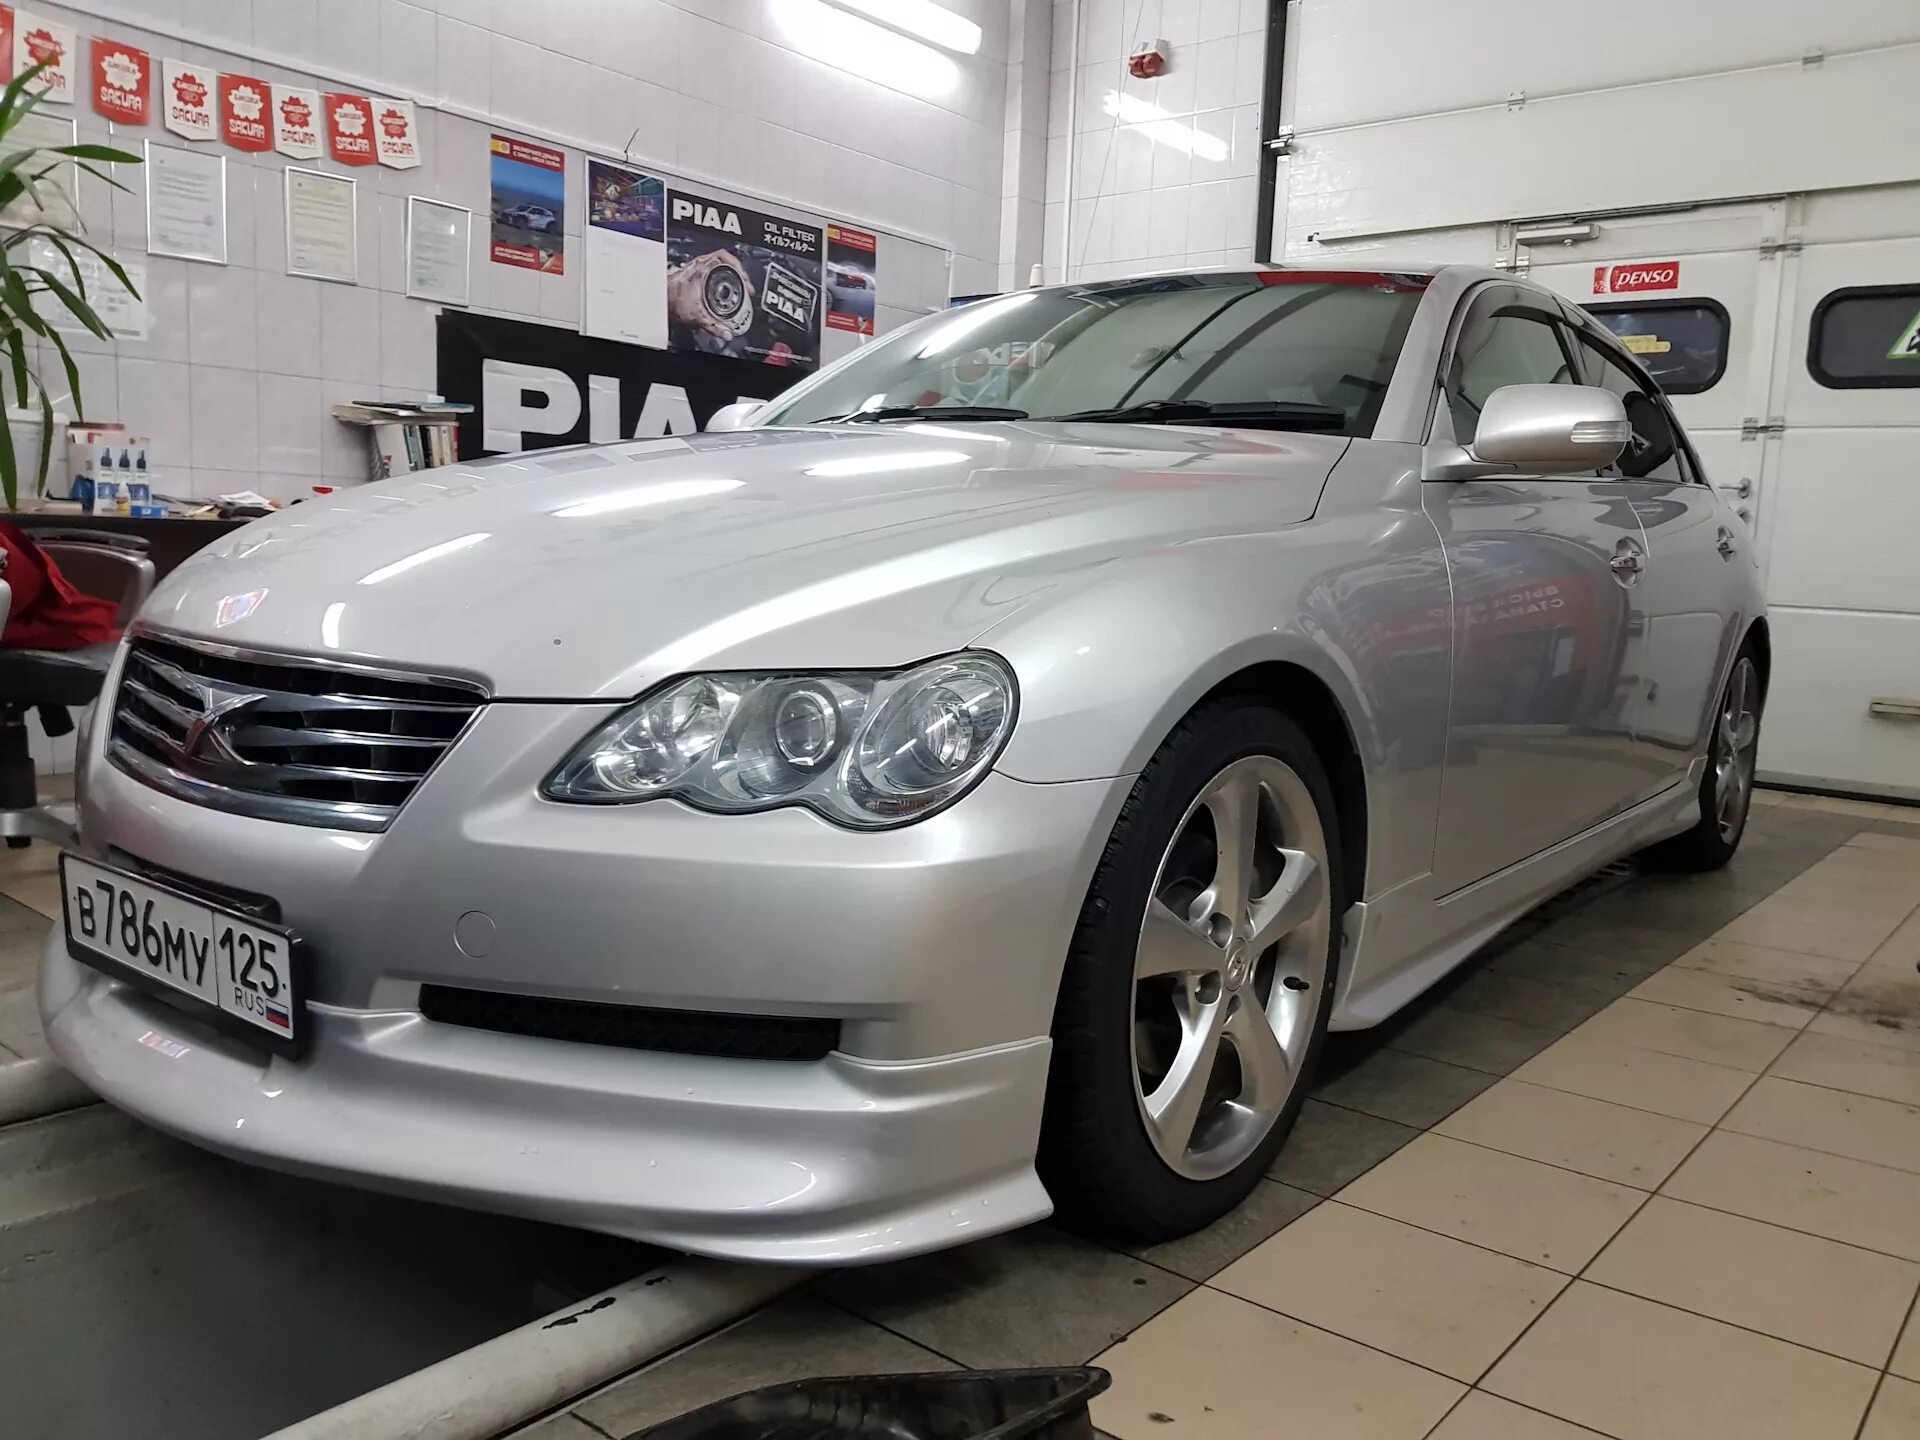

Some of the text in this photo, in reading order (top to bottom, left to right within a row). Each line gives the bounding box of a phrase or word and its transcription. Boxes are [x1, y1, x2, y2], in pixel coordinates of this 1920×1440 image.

[100, 86, 142, 112] SAKURA
[172, 107, 210, 126] SAKURA
[229, 119, 266, 139] SAKURA
[281, 129, 315, 145] SAKURA
[335, 136, 370, 152] SAKURA
[672, 197, 742, 235] PIAA
[764, 221, 816, 243] OIL FILTER
[764, 233, 816, 253] オイルフィルター
[1615, 269, 1674, 290] DENSO
[766, 290, 805, 323] PIAA
[482, 358, 769, 453] PIA
[77, 879, 279, 998] В786МУ 125
[234, 987, 265, 1017] RUS
